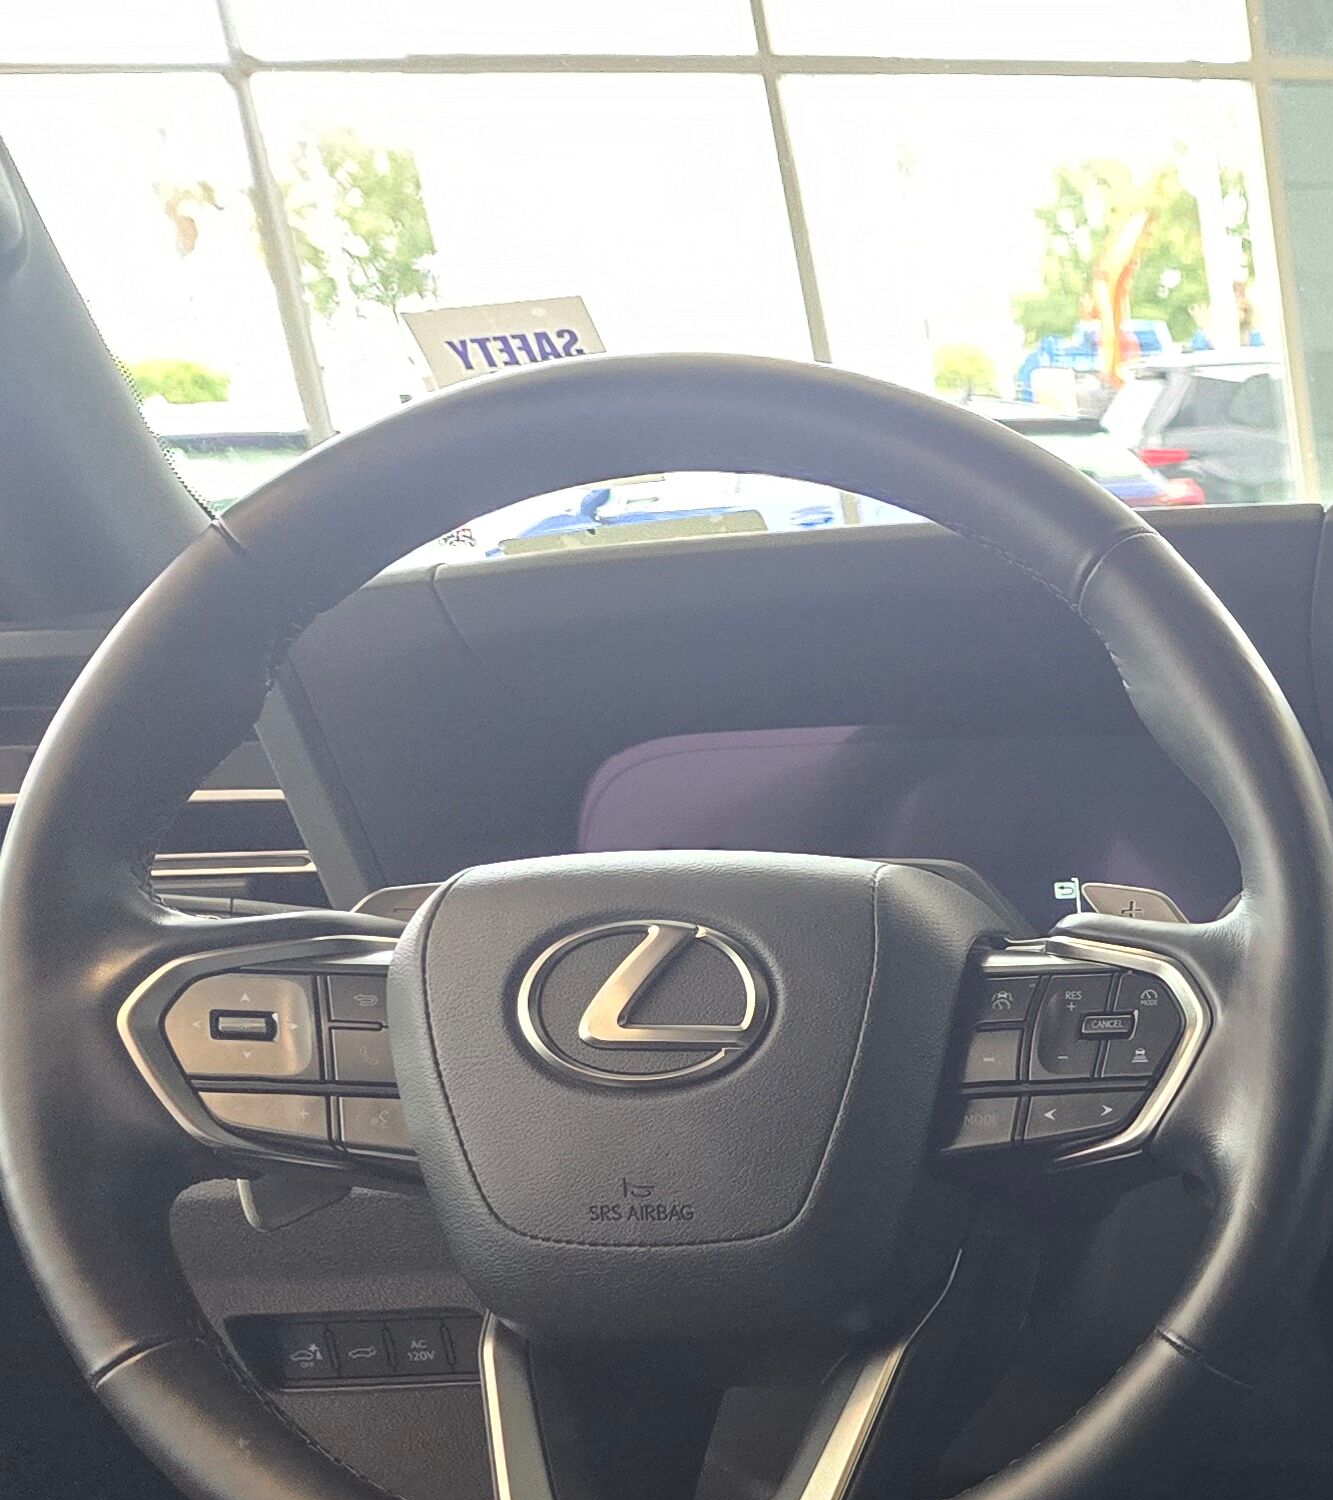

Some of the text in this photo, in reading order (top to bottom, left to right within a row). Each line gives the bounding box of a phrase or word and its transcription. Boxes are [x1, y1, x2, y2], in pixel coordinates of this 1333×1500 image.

[1064, 990, 1083, 1001] RES
[1090, 1019, 1125, 1030] CANCEL
[589, 1203, 694, 1221] SRS AIRBAG
[410, 1339, 428, 1349] AC
[407, 1350, 436, 1362] 120V
